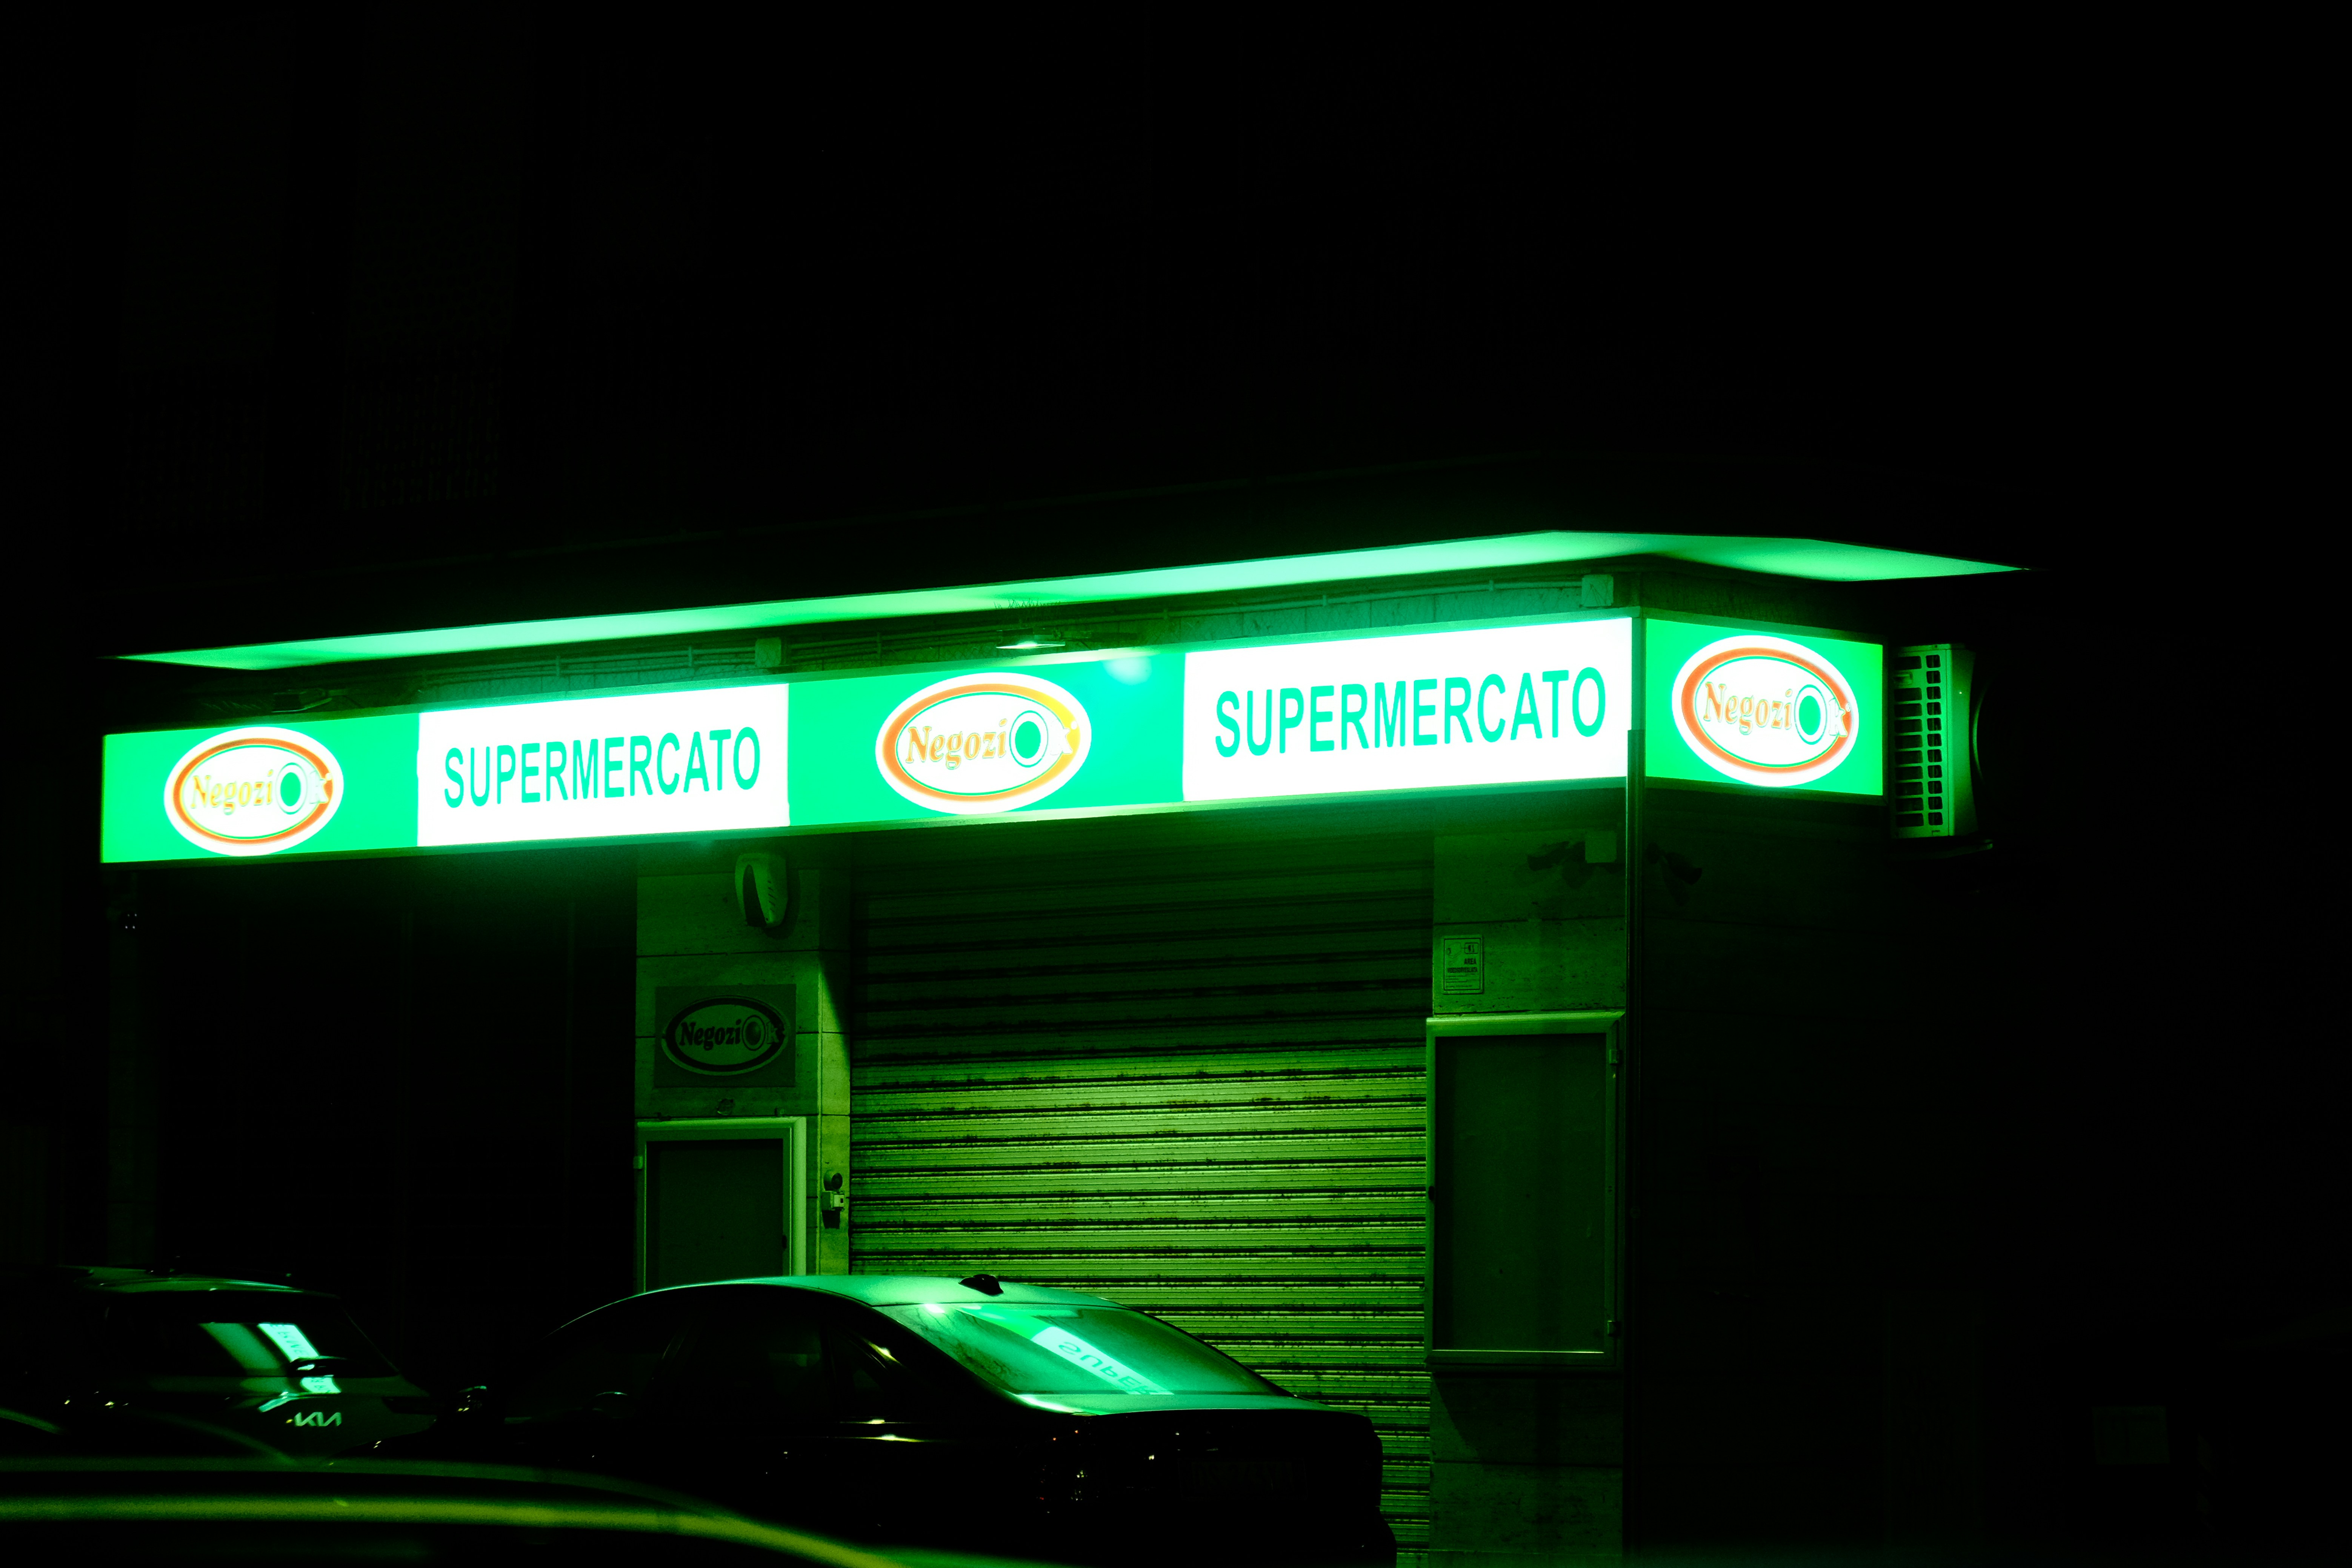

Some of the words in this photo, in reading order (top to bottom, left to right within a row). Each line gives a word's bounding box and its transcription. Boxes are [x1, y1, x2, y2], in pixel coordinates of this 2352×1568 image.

[1215, 667, 1605, 757] SUPERMERCATO
[445, 727, 760, 808] SUPERMERCATO
[294, 1412, 341, 1426] KIA
